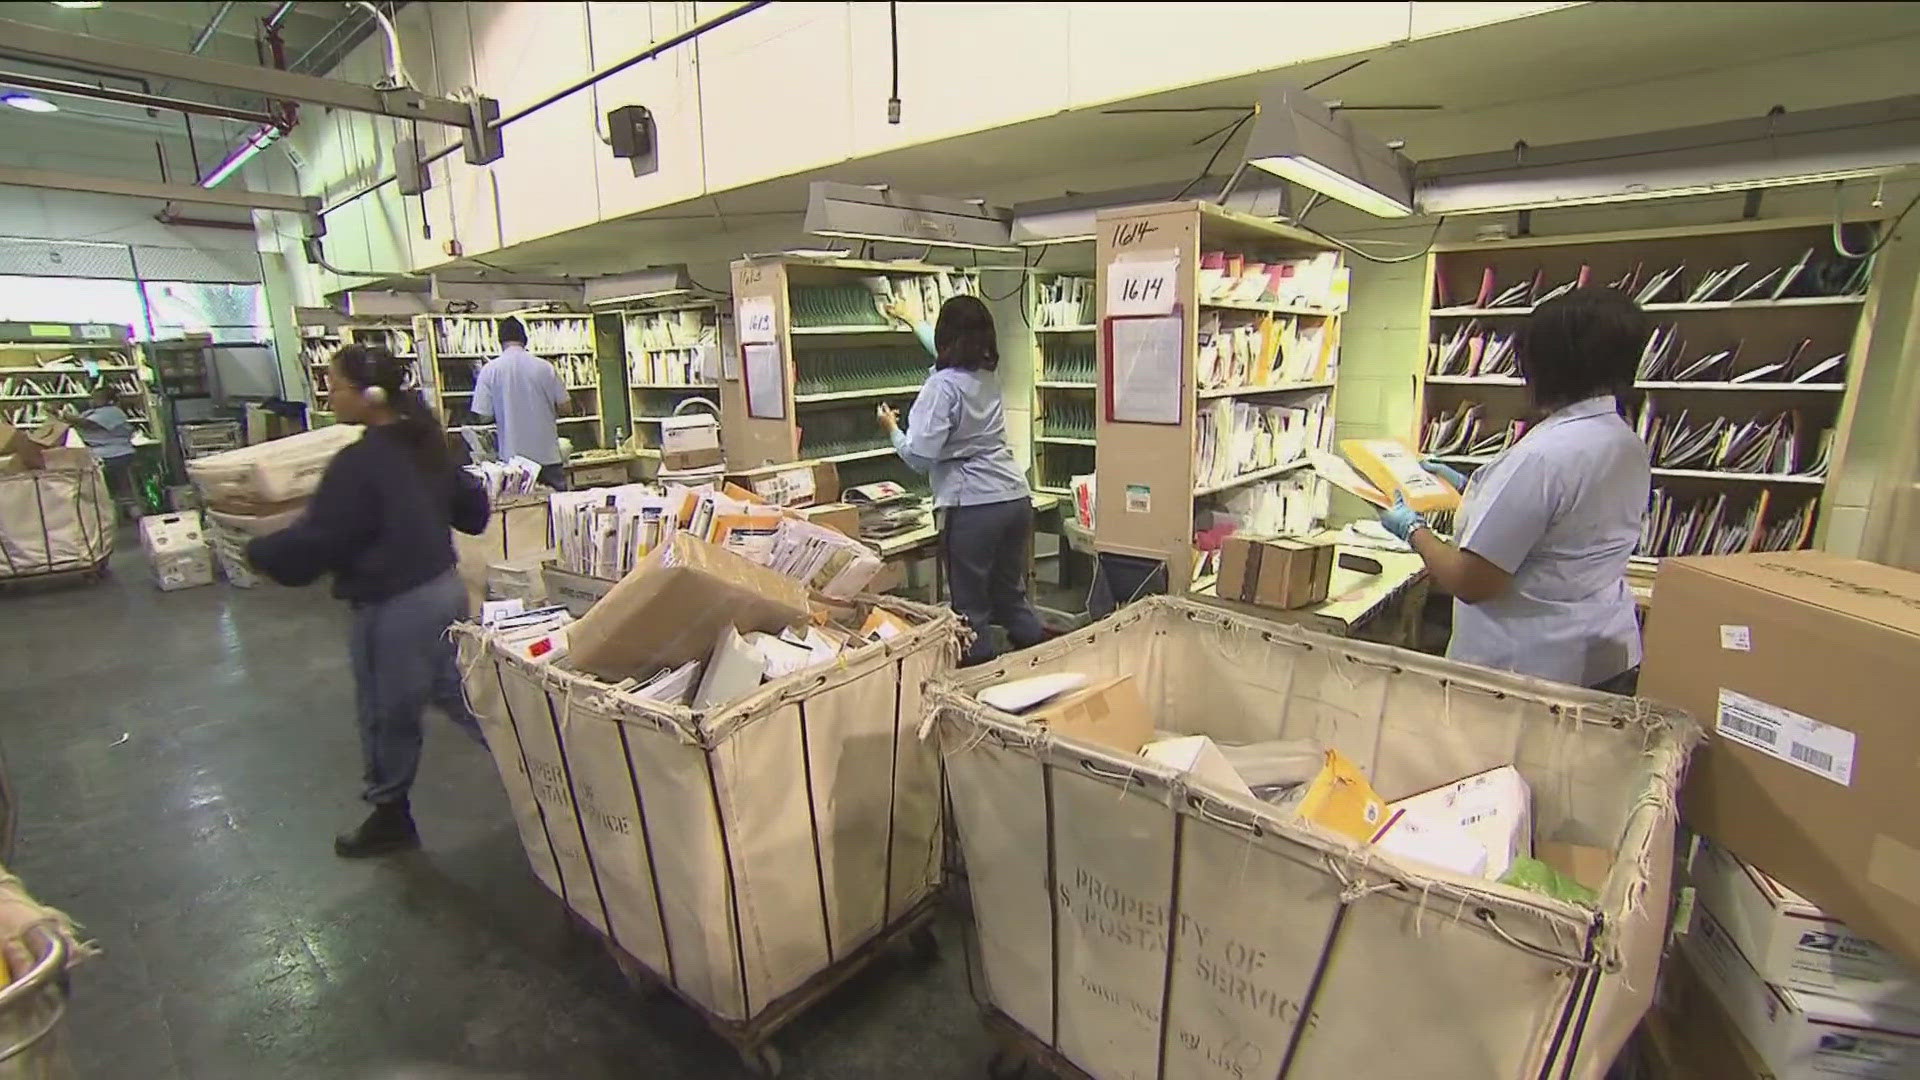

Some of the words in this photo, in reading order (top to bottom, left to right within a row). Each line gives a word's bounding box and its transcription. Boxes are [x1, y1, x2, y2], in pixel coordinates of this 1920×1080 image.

[1111, 220, 1158, 248] 1614
[1122, 277, 1164, 302] 1614
[1225, 939, 1266, 974] OF
